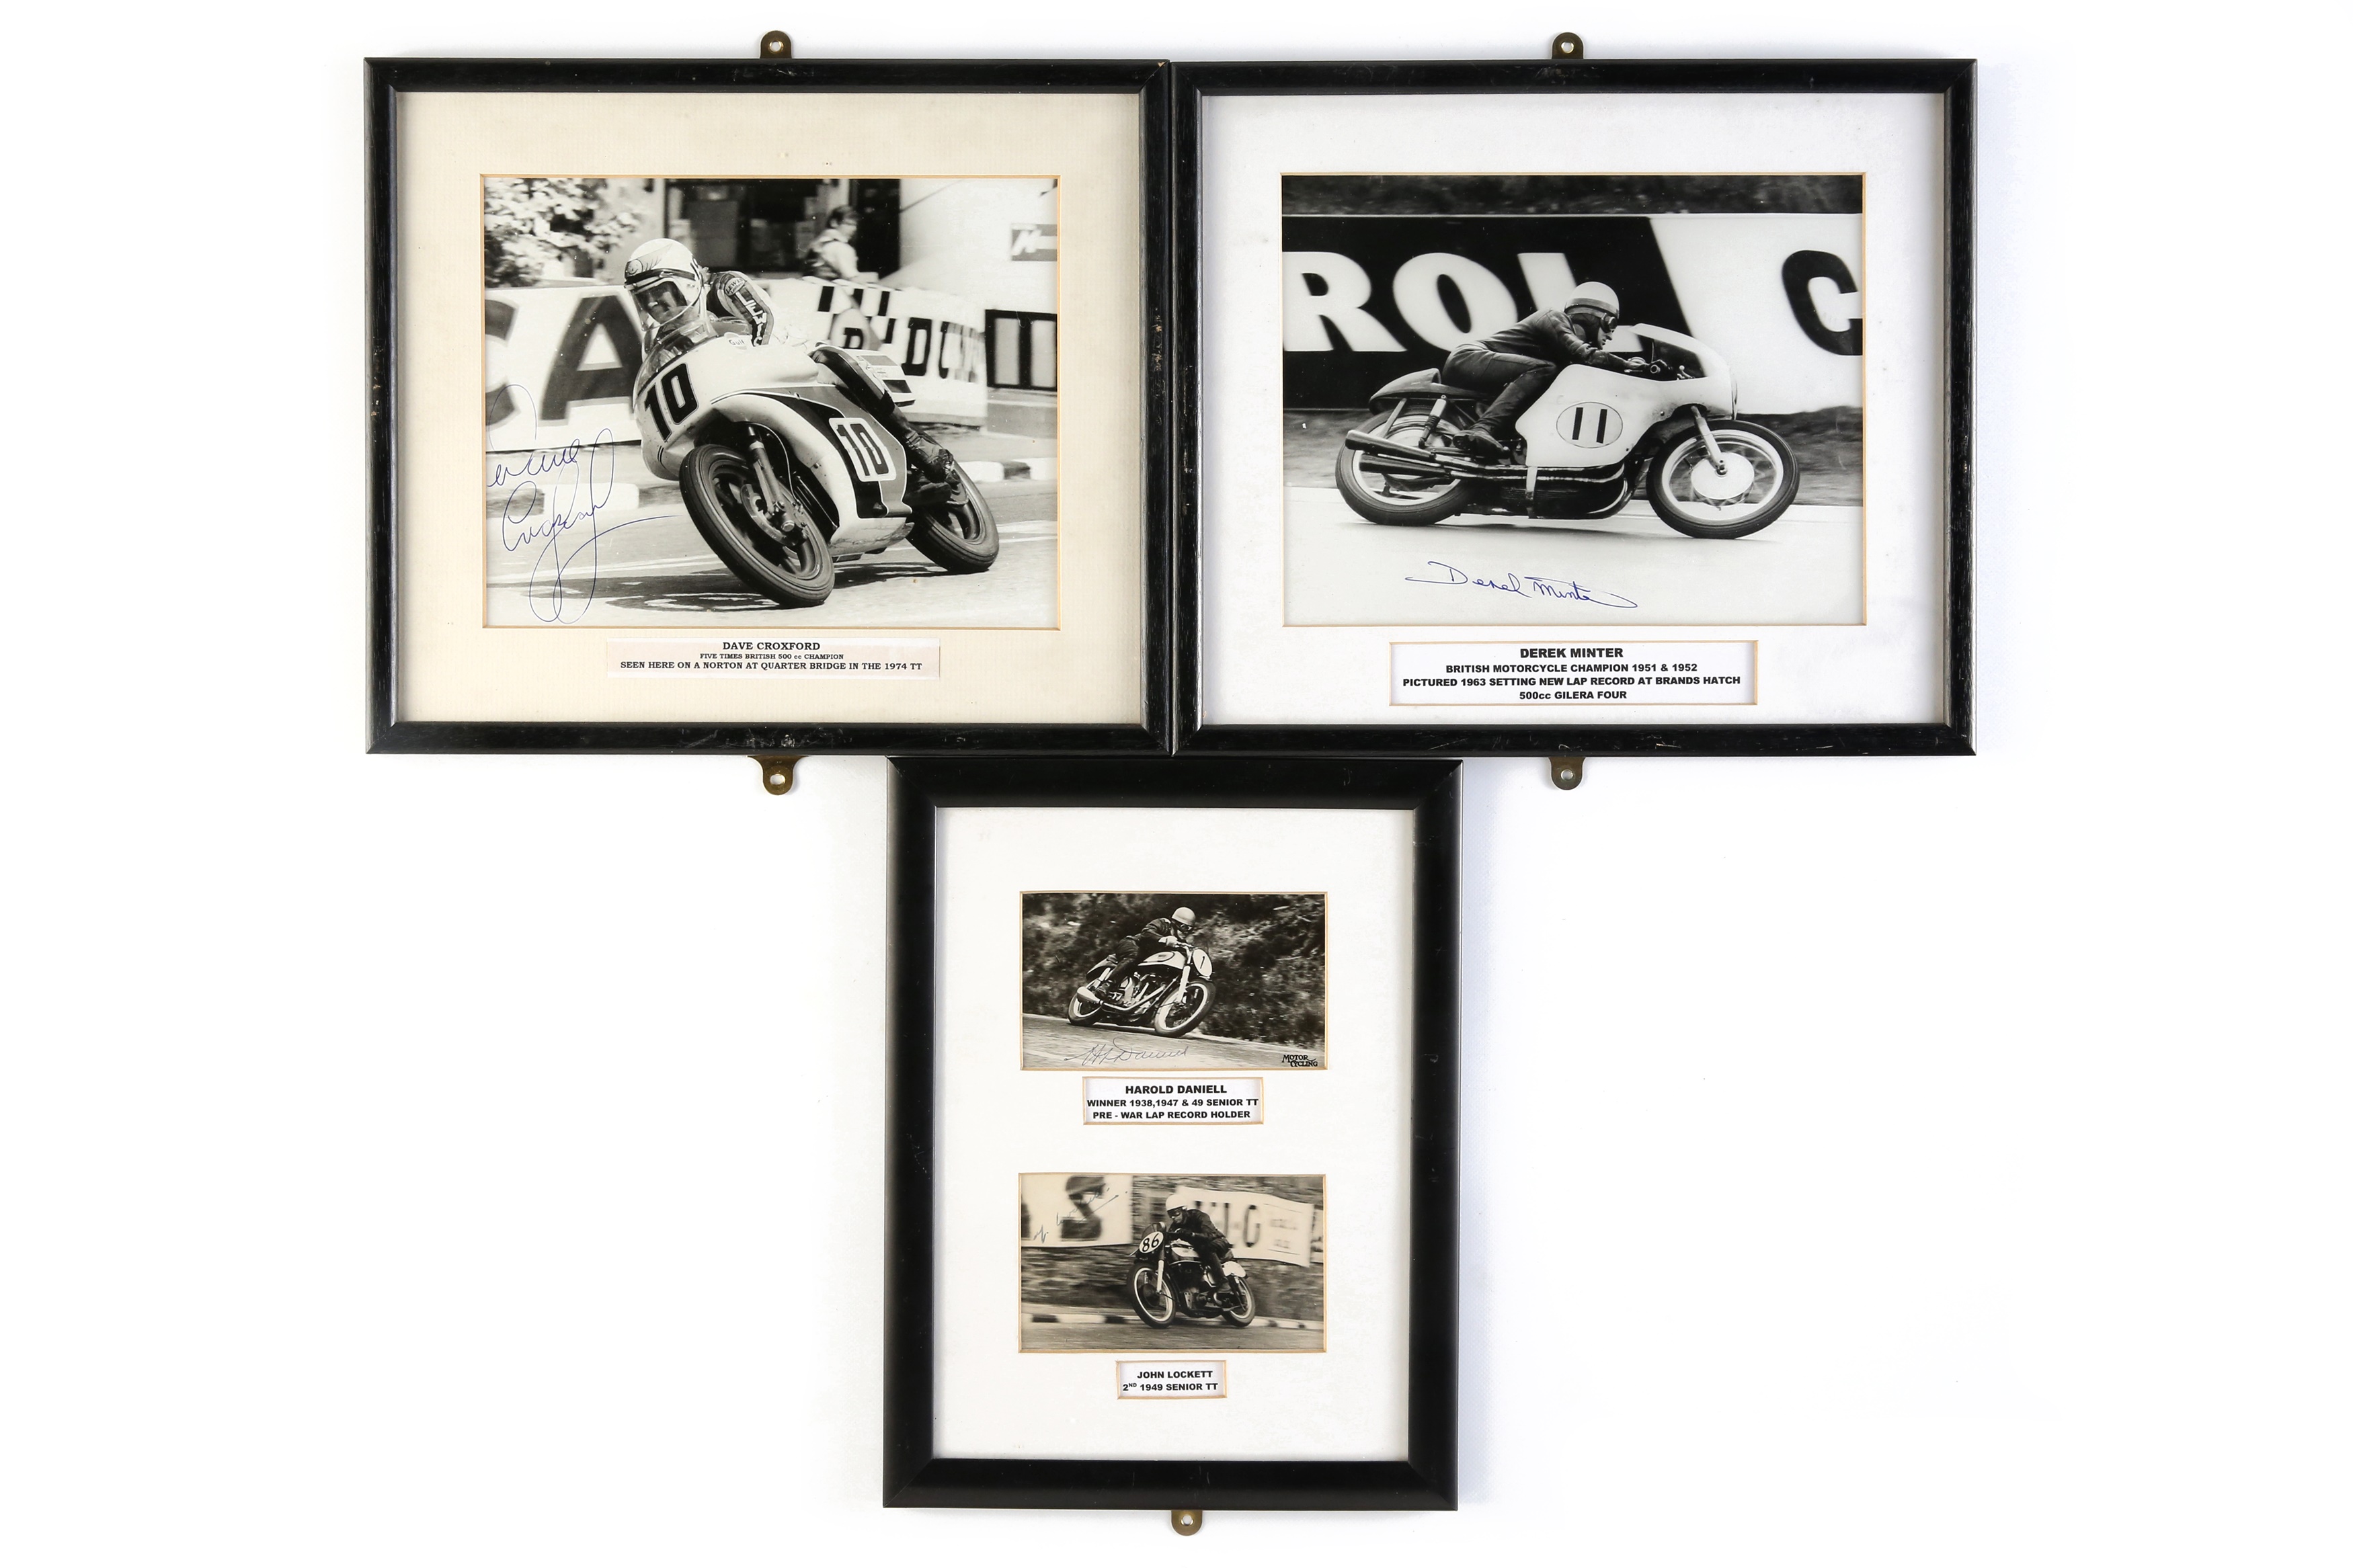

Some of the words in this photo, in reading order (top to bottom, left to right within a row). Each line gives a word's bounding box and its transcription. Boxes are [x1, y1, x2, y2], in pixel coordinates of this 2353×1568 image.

[644, 364, 699, 443] 10
[1572, 407, 1607, 444] 11
[838, 423, 889, 476] 10
[723, 642, 754, 651] DAVE
[756, 642, 820, 651] CROXFORD
[1520, 647, 1566, 659] DEREK
[1570, 647, 1624, 659] MINTER
[760, 662, 807, 671] QUARTER
[809, 662, 846, 670] BRIDGE
[885, 663, 908, 671] 1974
[910, 663, 922, 671] TT
[1446, 665, 1490, 673] BRITISH
[1492, 664, 1568, 673] MOTORCYCLE
[1570, 663, 1628, 673] CHAMPION
[1632, 663, 1656, 672] 1951
[1661, 663, 1669, 672] &
[1672, 663, 1698, 672] 1952
[1403, 678, 1458, 687] PICTURED
[1461, 678, 1486, 687] 1963
[1489, 677, 1536, 686] SETTING
[1539, 677, 1564, 686] NEW
[1566, 677, 1587, 686] LAP
[1590, 677, 1635, 686] RECORD
[1638, 677, 1652, 685] AT
[1655, 676, 1700, 685] BRANDS
[1703, 676, 1741, 685] HATCH
[1519, 691, 1551, 700] 500cc
[1554, 691, 1595, 700] GILERA
[1597, 691, 1627, 700] FOUR
[1125, 1085, 1174, 1094] HAROLD
[1177, 1085, 1228, 1094] DANIELL
[1086, 1099, 1127, 1107] WINNER
[1129, 1099, 1179, 1108] 1938,1947
[1181, 1098, 1189, 1107] &
[1191, 1098, 1203, 1106] 49
[1206, 1098, 1243, 1106] SENIOR
[1167, 1111, 1207, 1119] RECORD
[1211, 1110, 1250, 1118] HOLDER
[1142, 1233, 1159, 1252] 86
[1137, 1371, 1164, 1379] JOHN
[1167, 1370, 1213, 1378] LOCKETT
[1140, 1383, 1163, 1391] 1949
[1166, 1383, 1203, 1391] SENIOR
[1205, 1383, 1218, 1391] TT
